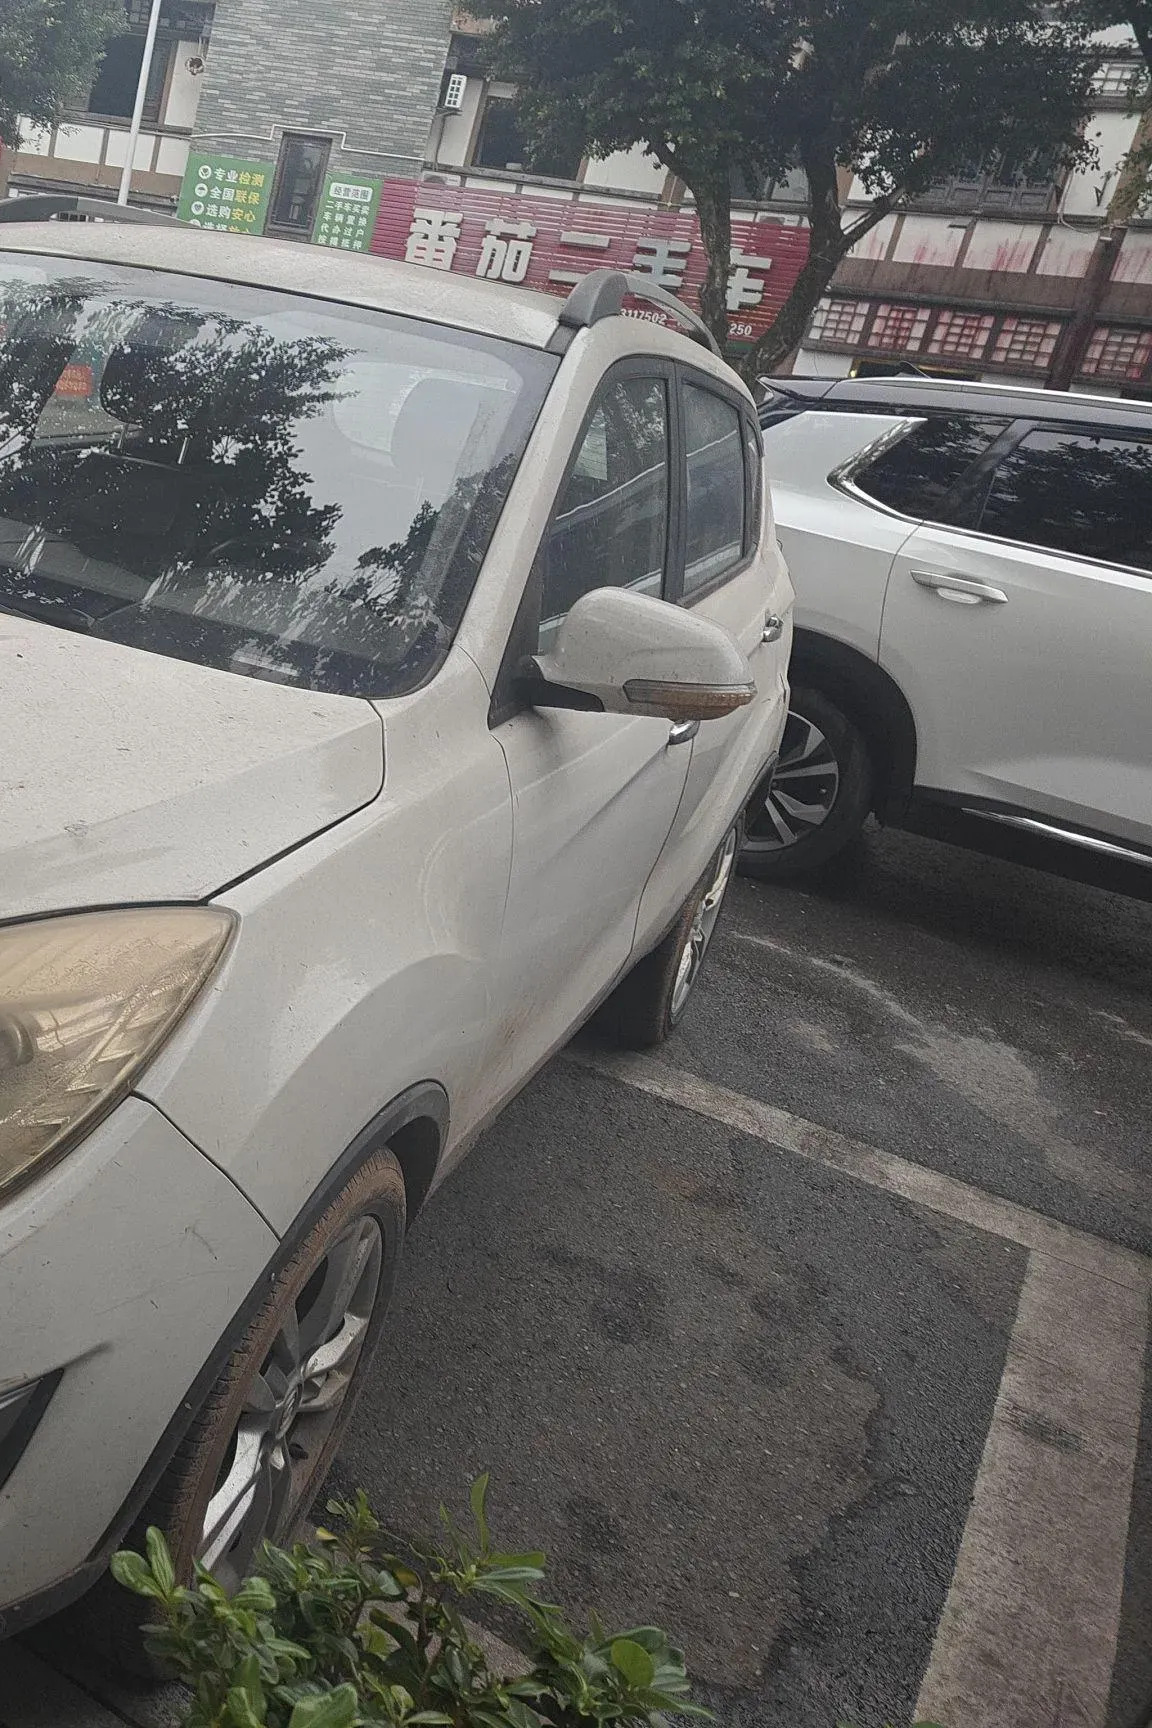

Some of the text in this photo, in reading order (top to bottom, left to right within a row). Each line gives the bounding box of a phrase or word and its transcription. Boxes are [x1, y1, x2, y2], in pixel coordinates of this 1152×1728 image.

[214, 167, 265, 188] 专业检测
[209, 186, 261, 205] 全国联保
[205, 203, 257, 223] 选购安心
[325, 199, 370, 216] 二手车买卖
[405, 208, 772, 311] 番茄二手车
